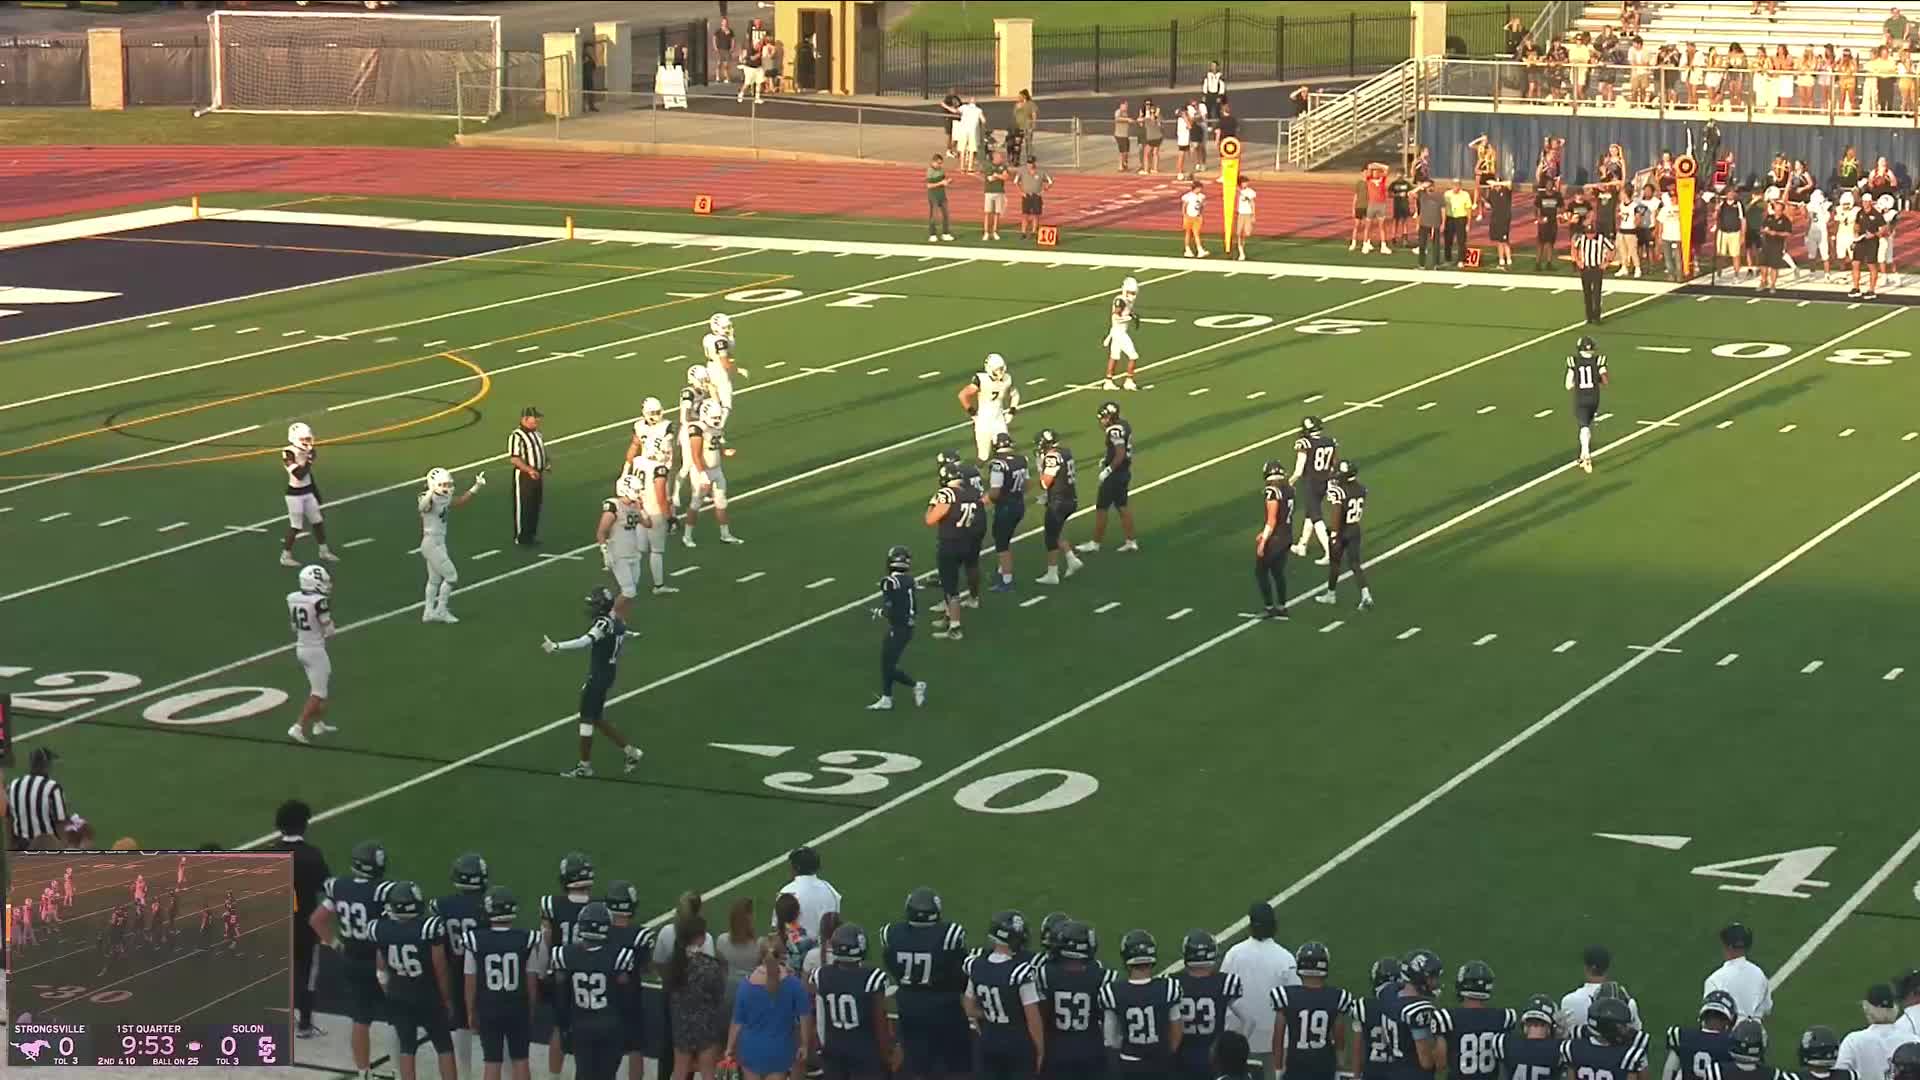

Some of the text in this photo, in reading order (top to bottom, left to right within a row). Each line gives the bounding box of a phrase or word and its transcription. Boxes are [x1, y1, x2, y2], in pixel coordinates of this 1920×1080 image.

[1579, 365, 1594, 389] 11
[1314, 446, 1334, 471] 87
[956, 502, 977, 528] 76
[336, 901, 369, 940] 33
[387, 943, 423, 978] 46
[485, 952, 519, 992] 60
[897, 951, 932, 985] 77
[572, 971, 607, 1010] 62
[977, 984, 1009, 1024] 31
[827, 992, 860, 1031] 10
[1054, 991, 1091, 1031] 53
[1126, 1005, 1159, 1044] 21
[1182, 997, 1217, 1035] 23
[1297, 1008, 1329, 1050] 19
[1460, 1031, 1496, 1075] 88
